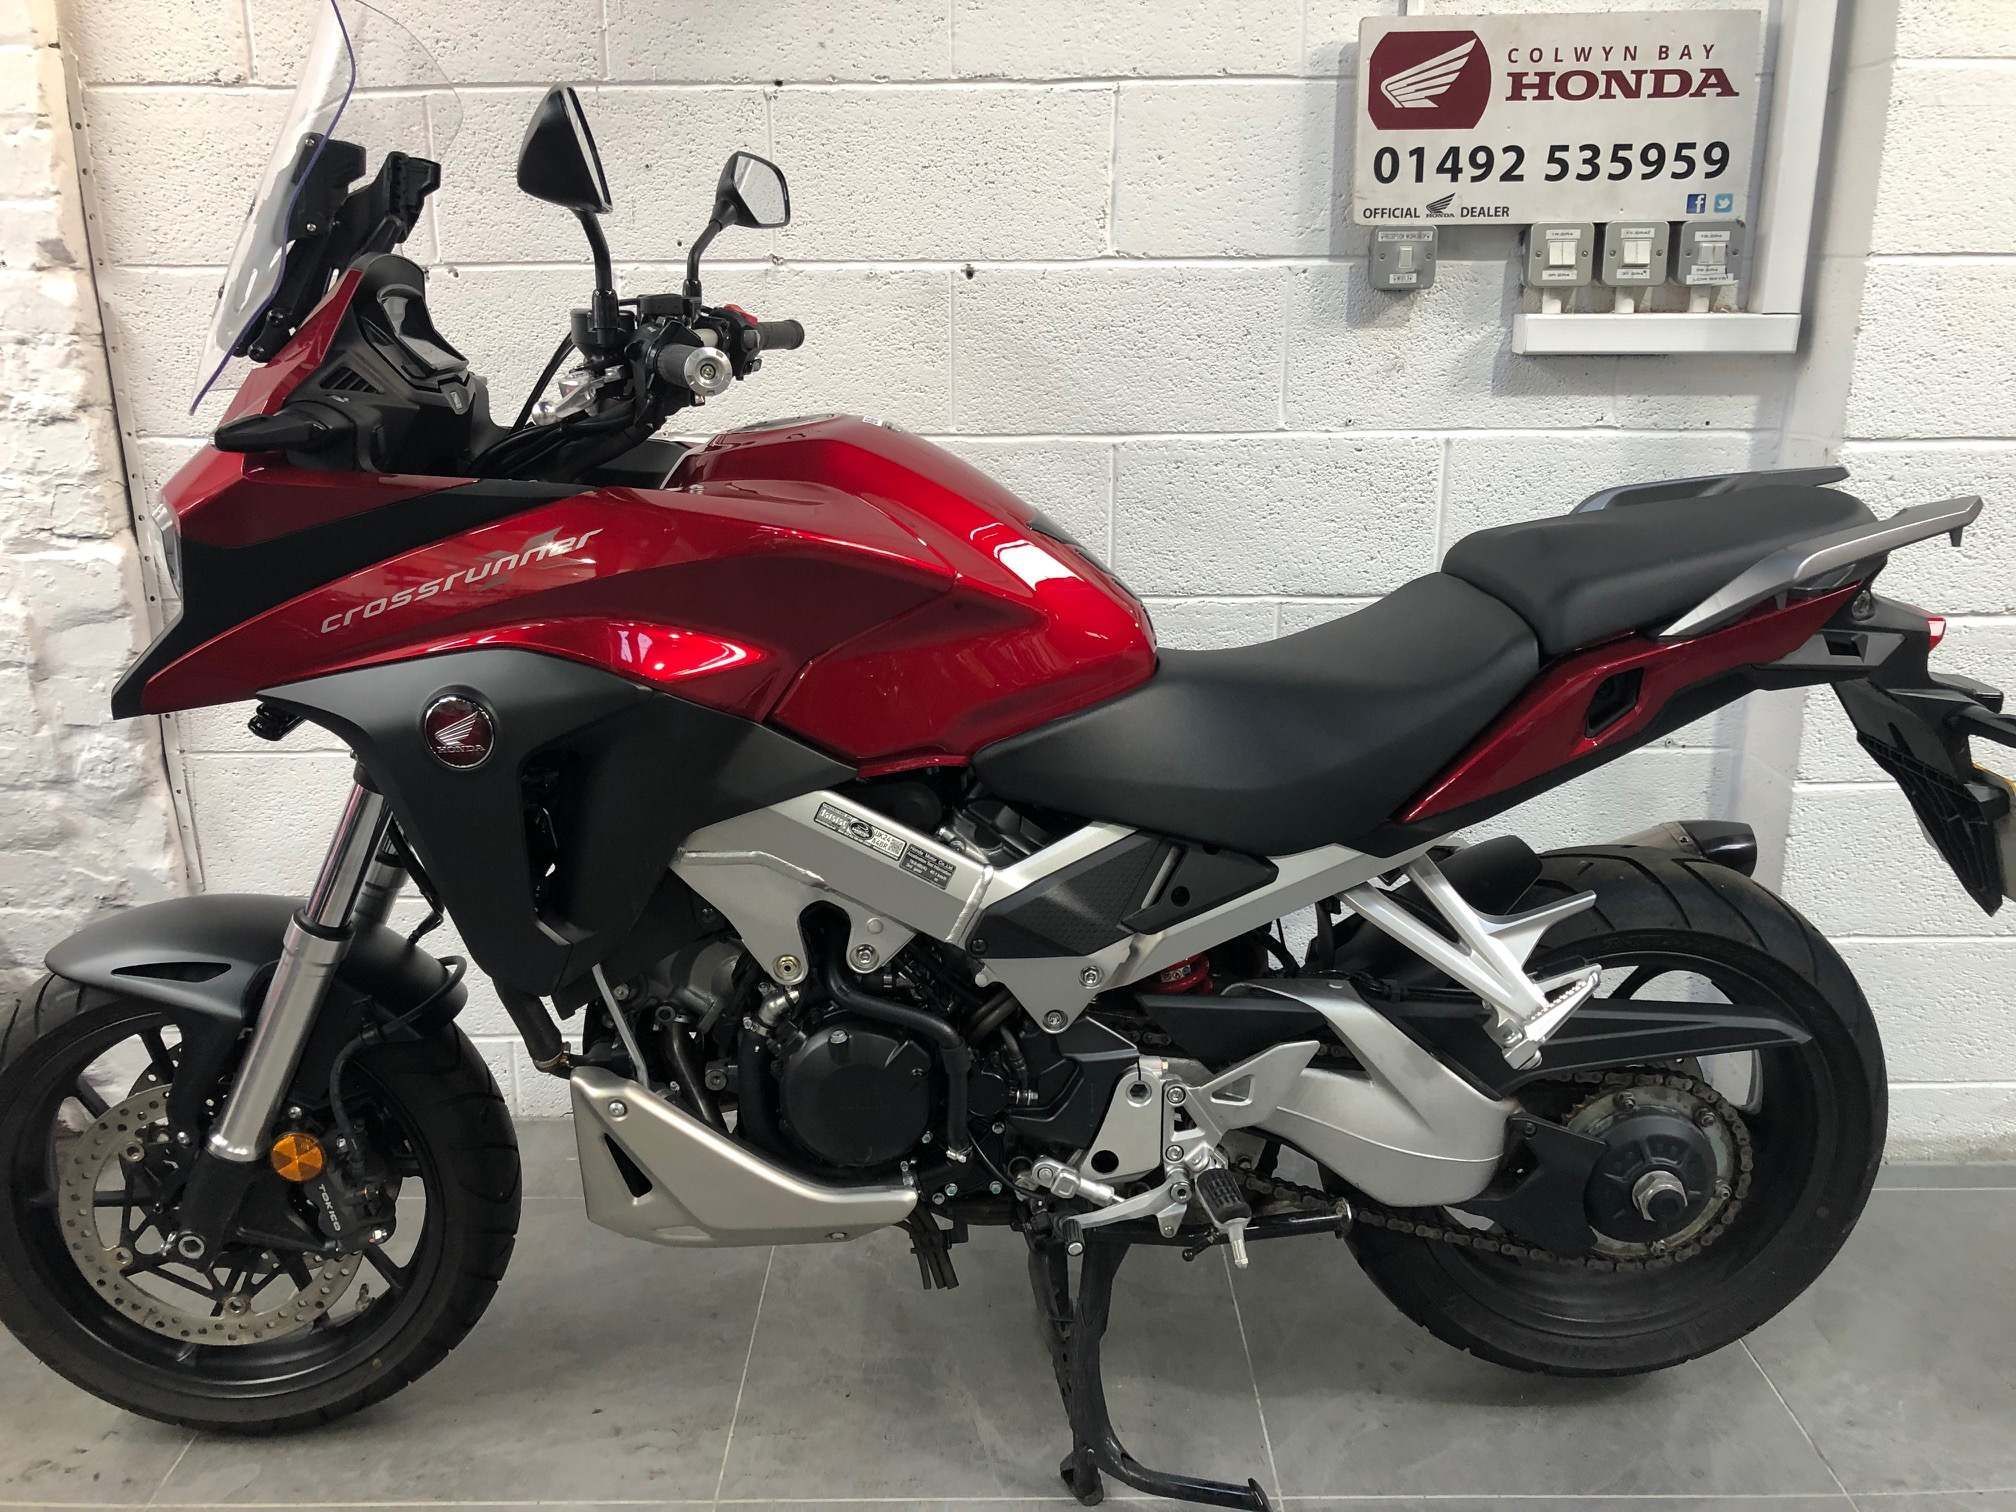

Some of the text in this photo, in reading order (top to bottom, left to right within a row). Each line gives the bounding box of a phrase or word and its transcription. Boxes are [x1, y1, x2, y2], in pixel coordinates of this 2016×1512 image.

[1507, 43, 1716, 64] COLWYN BAY
[1505, 67, 1740, 102] HONDA
[1373, 141, 1731, 184] 01492 535959
[1362, 207, 1421, 219] OFFICIAL
[1460, 206, 1510, 218] DEALER
[320, 528, 604, 634] crossrunner
[436, 743, 485, 754] HONDA
[317, 1183, 342, 1232] TOKICO
